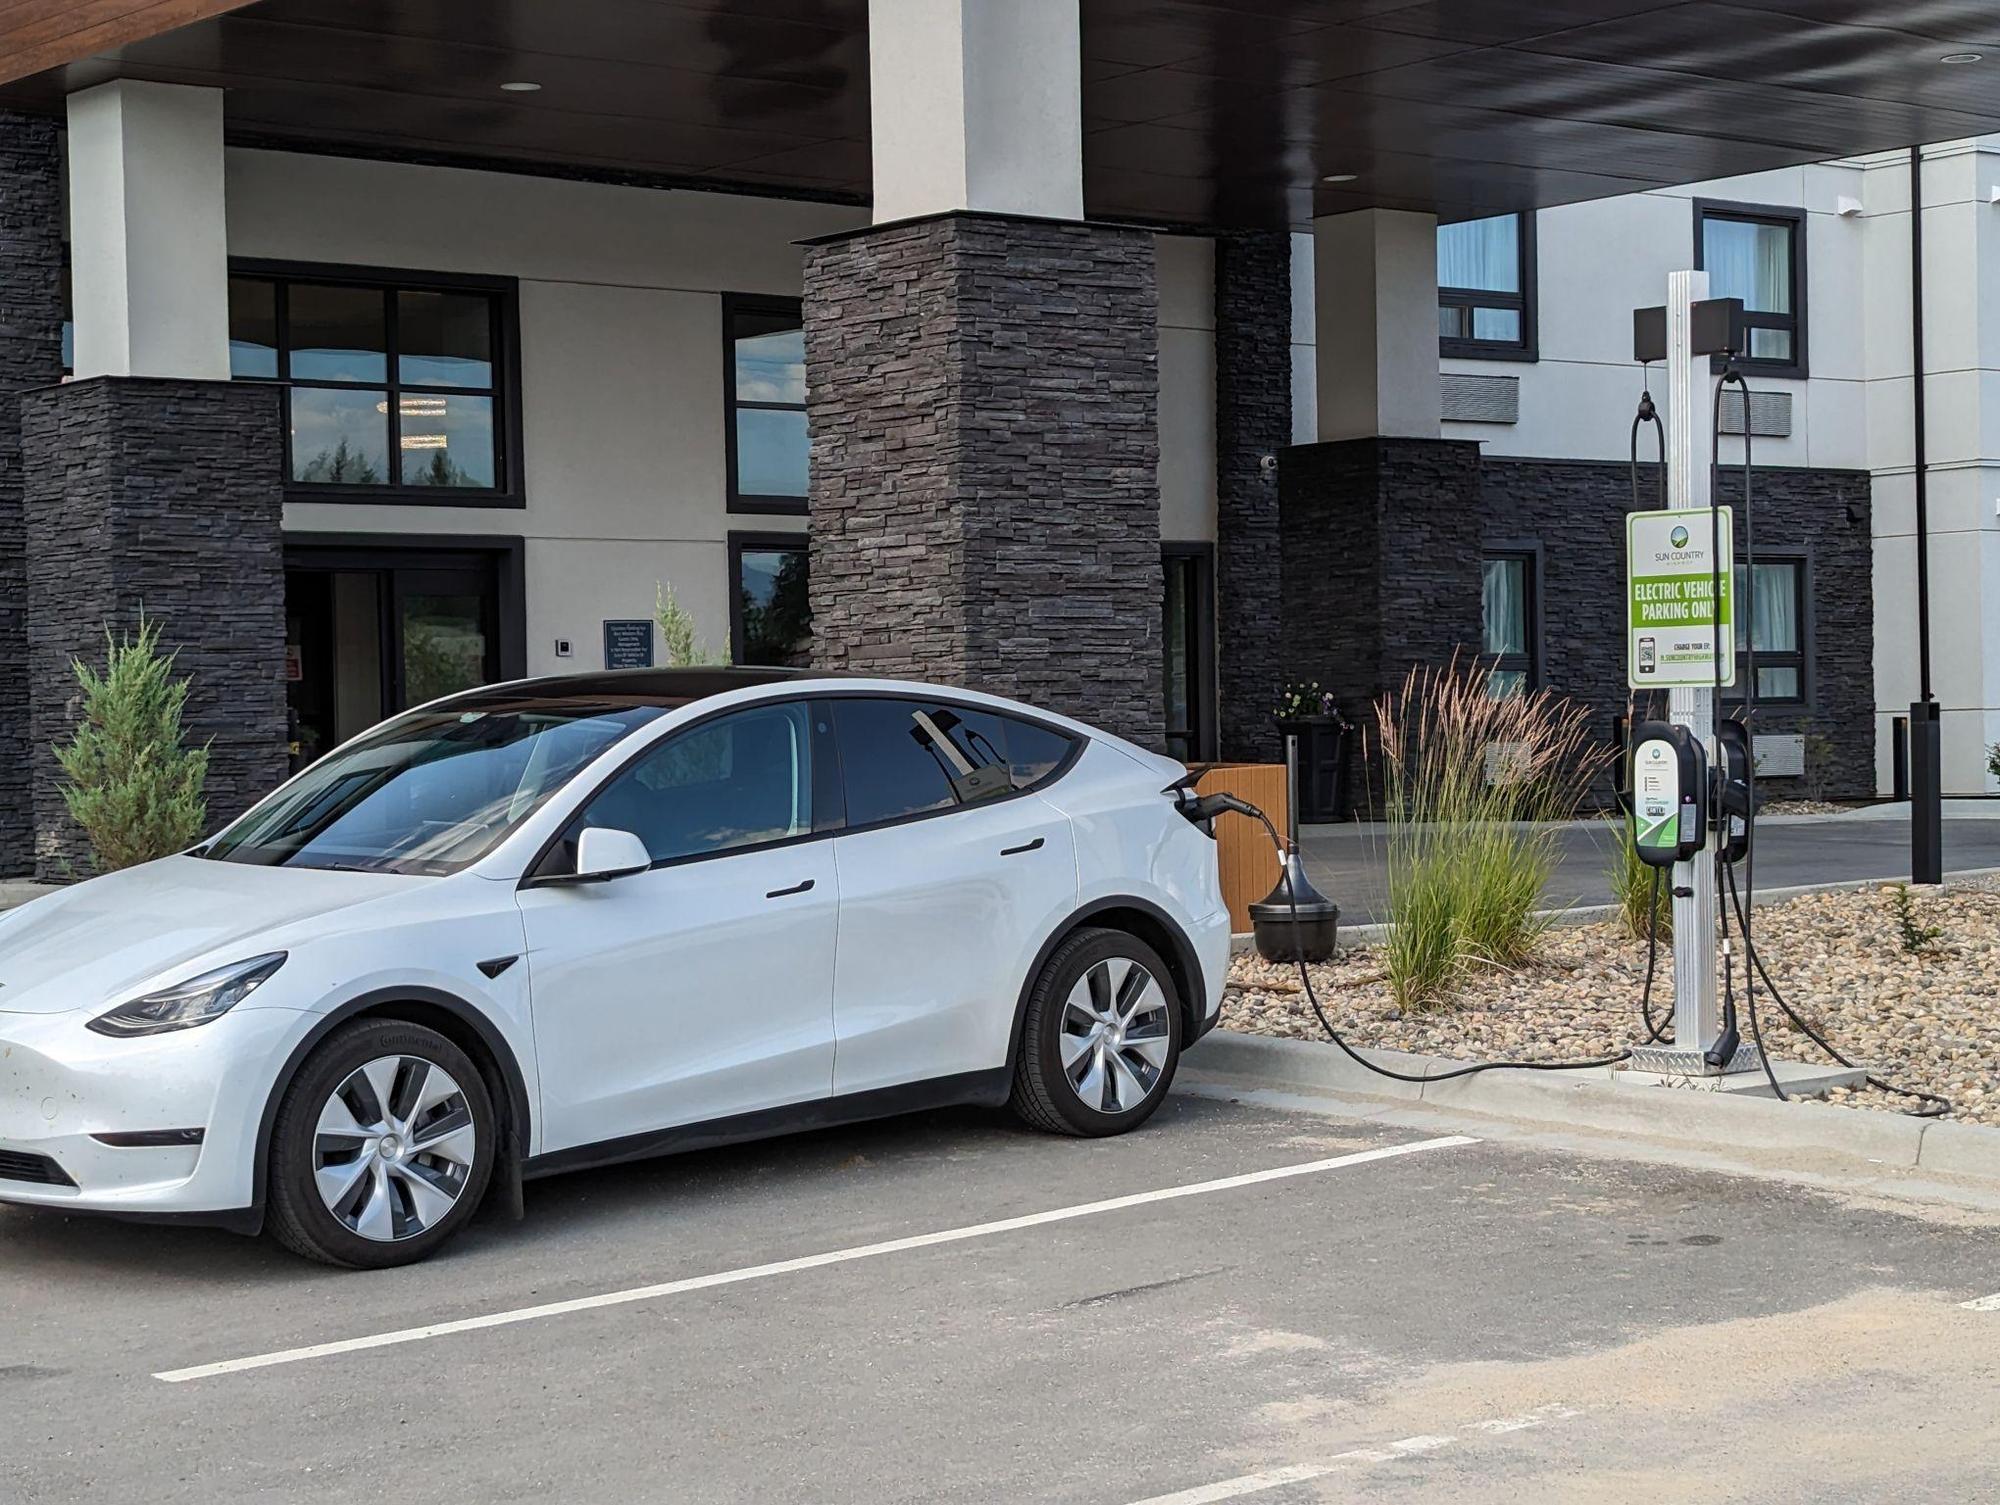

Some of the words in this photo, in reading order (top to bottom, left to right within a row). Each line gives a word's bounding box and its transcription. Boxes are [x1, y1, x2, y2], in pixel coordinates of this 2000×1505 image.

[1655, 553, 1669, 561] SUN
[1671, 551, 1704, 560] COUNTRY
[1635, 583, 1680, 600] ELECTRIC
[1684, 580, 1725, 598] VEHICE
[1642, 603, 1688, 620] PARKING
